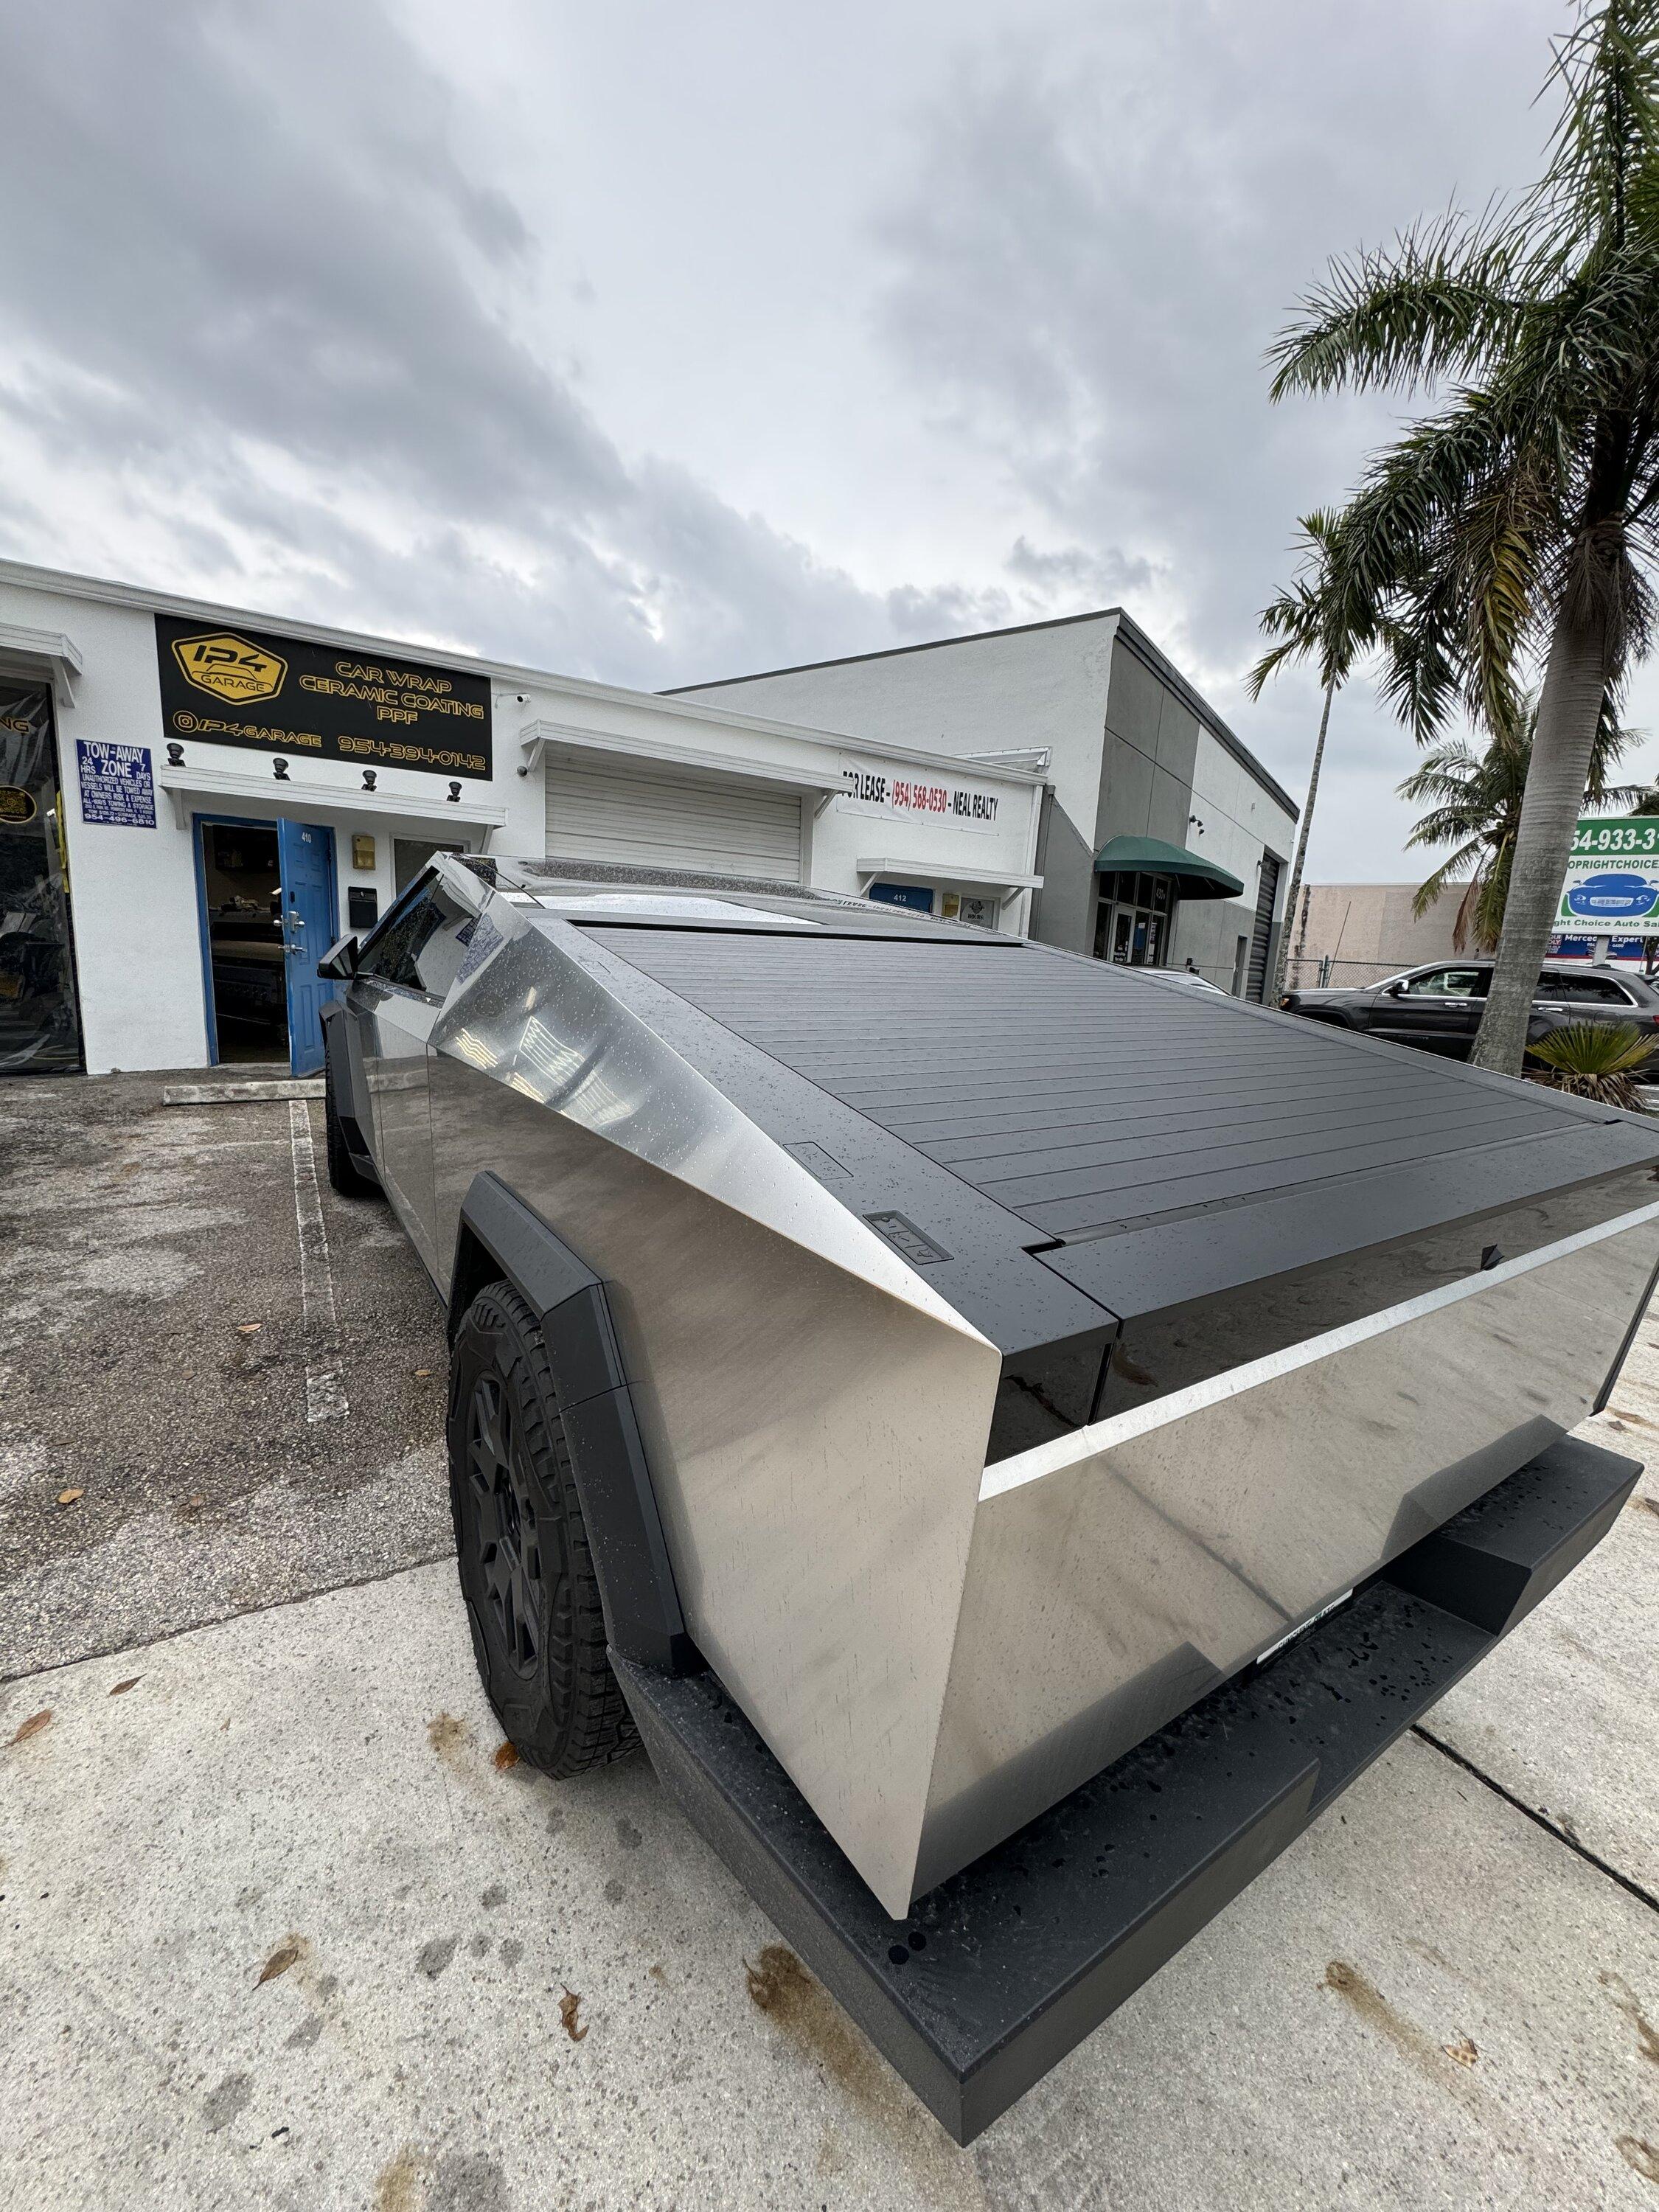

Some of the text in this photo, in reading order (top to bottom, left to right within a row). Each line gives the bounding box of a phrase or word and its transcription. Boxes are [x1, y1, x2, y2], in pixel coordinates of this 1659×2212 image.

[201, 673, 266, 692] GARAGE
[335, 661, 453, 695] CAR WRAP
[299, 675, 484, 720] CERAMIC COATING
[376, 706, 418, 725] PPF
[83, 741, 144, 763] TOW-AWAY
[338, 736, 487, 771] 954-394-0142
[82, 756, 93, 765] 24
[139, 763, 146, 772] 7
[80, 765, 96, 774] HRS
[101, 759, 132, 778] ZONE
[136, 771, 151, 781] DAYS
[80, 782, 102, 790] VESSELS
[116, 785, 123, 793] BE
[82, 773, 151, 788] UNAUTHORIZED VEHICLES OR
[131, 795, 153, 804] EXPENSE
[860, 773, 886, 803] LEASE
[891, 779, 912, 812] (954)
[912, 785, 947, 813] 568-0530
[953, 790, 971, 817] NEAL
[972, 794, 998, 821] REALTY
[301, 831, 312, 843] 410
[1571, 827, 1659, 852] 54-933-3
[1568, 860, 1659, 869] OPRIGHTCHOICE
[893, 894, 907, 902] 412
